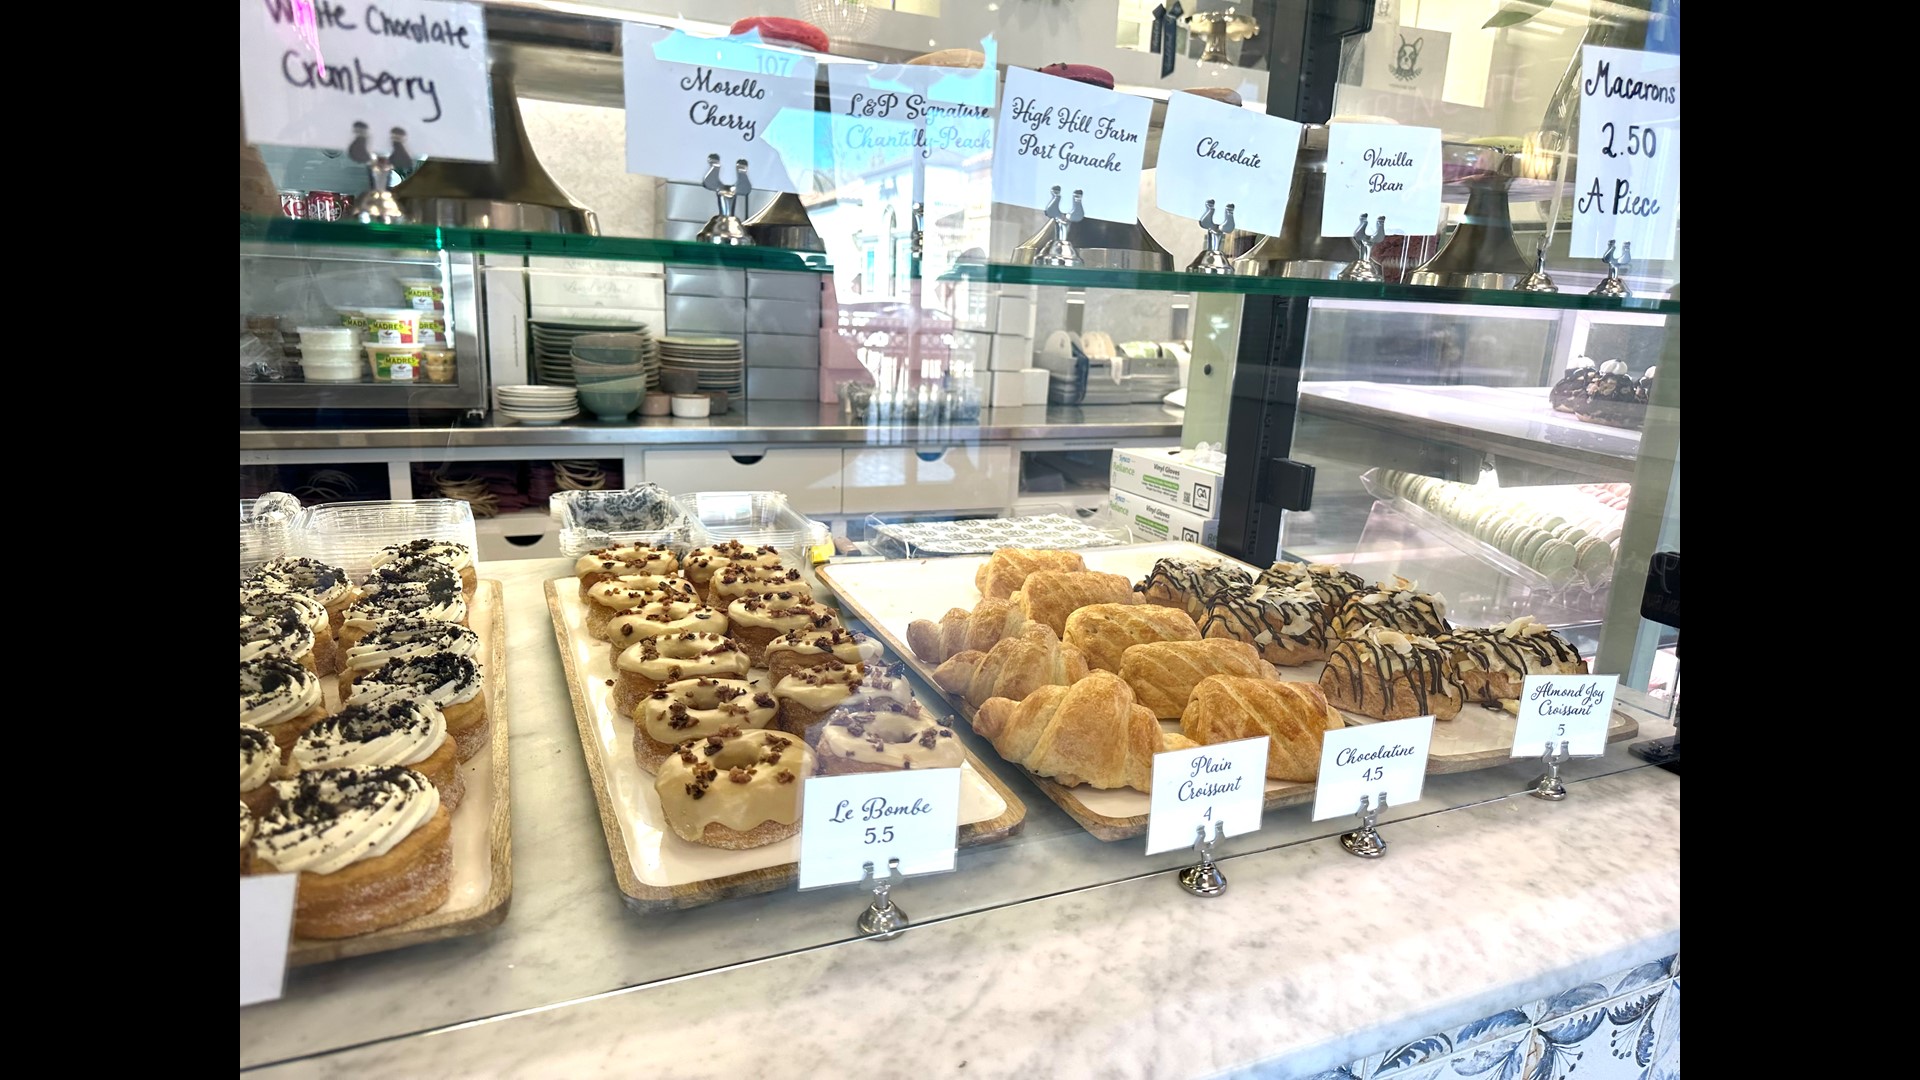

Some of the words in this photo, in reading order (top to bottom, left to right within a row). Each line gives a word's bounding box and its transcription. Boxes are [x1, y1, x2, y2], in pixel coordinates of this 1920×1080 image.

[265, 0, 357, 30] Wite
[365, 5, 470, 49] Chocolate
[757, 54, 790, 77] 107
[282, 50, 442, 123] Cranberry
[680, 66, 765, 100] Morello
[1585, 60, 1675, 105] Macarons
[689, 100, 756, 141] Cherry
[846, 93, 899, 118] L&P
[905, 94, 990, 125] Signature
[1012, 97, 1054, 131] High
[1057, 107, 1093, 133] Hill
[1094, 117, 1138, 143] Farm
[1601, 122, 1657, 158] 2.50
[1018, 133, 1056, 159] Port
[1058, 141, 1122, 171] Ganache
[1196, 137, 1261, 169] Chocolate
[1363, 148, 1414, 169] Vanilla
[1369, 173, 1404, 193] Bean
[1578, 177, 1604, 214] A
[1612, 178, 1661, 217] Piece
[408, 289, 437, 298] MADRES
[374, 322, 404, 331] MADRES
[385, 357, 416, 365] MADRES
[1153, 463, 1165, 474] Vinyl
[1164, 466, 1180, 477] Gloves
[1146, 504, 1157, 516] Vinyl
[1156, 507, 1170, 519] Gloves
[1530, 681, 1585, 700] Almond
[1581, 682, 1605, 705] Joy
[1538, 699, 1593, 716] Croissant
[1556, 723, 1566, 736] 5
[1190, 755, 1232, 777] Plain
[1336, 744, 1415, 767] Chocolatine
[1362, 767, 1384, 782] 4.5
[1178, 776, 1242, 802] Croissant
[829, 799, 854, 823] Le
[861, 797, 933, 821] Bombe
[1203, 806, 1212, 821] 4
[864, 826, 894, 844] 5.5
